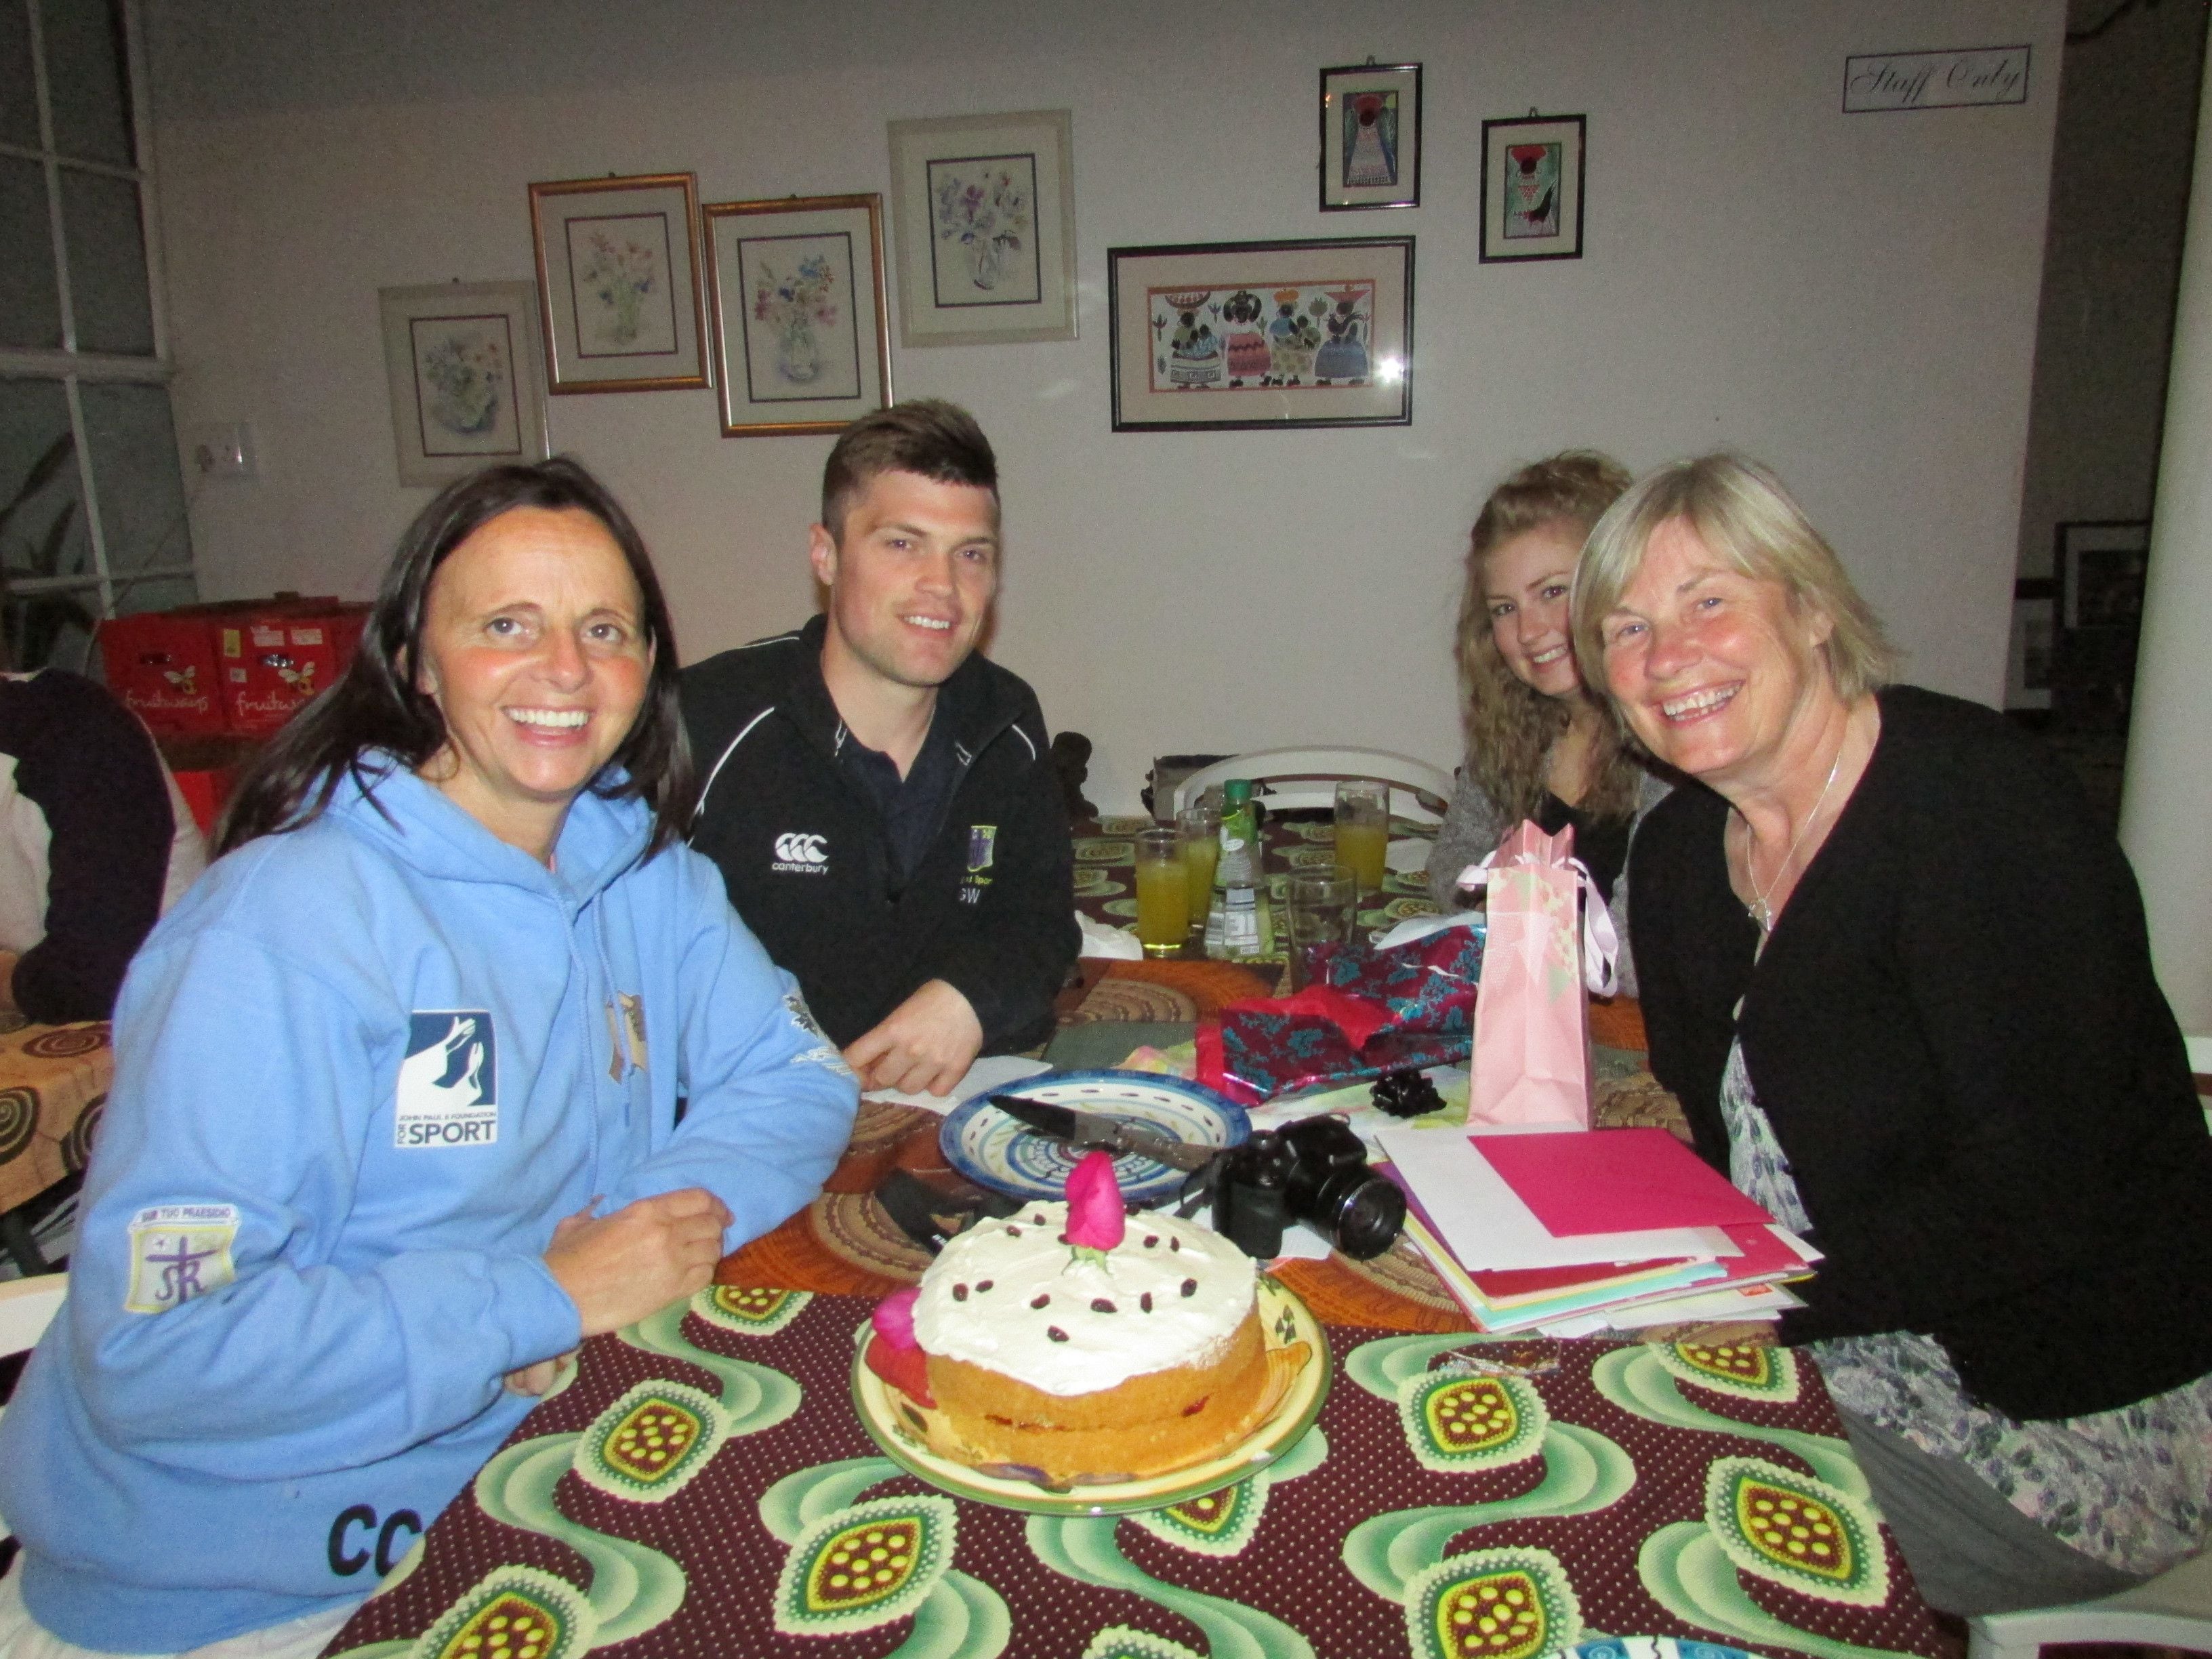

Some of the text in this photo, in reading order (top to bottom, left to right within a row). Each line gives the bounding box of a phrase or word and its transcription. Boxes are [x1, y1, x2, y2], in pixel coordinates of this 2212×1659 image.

[1850, 58, 2020, 103] Staff Only
[772, 862, 830, 876] canterbury
[396, 1124, 407, 1145] FOR
[409, 1120, 496, 1145] SPORT
[328, 1503, 423, 1578] CC
